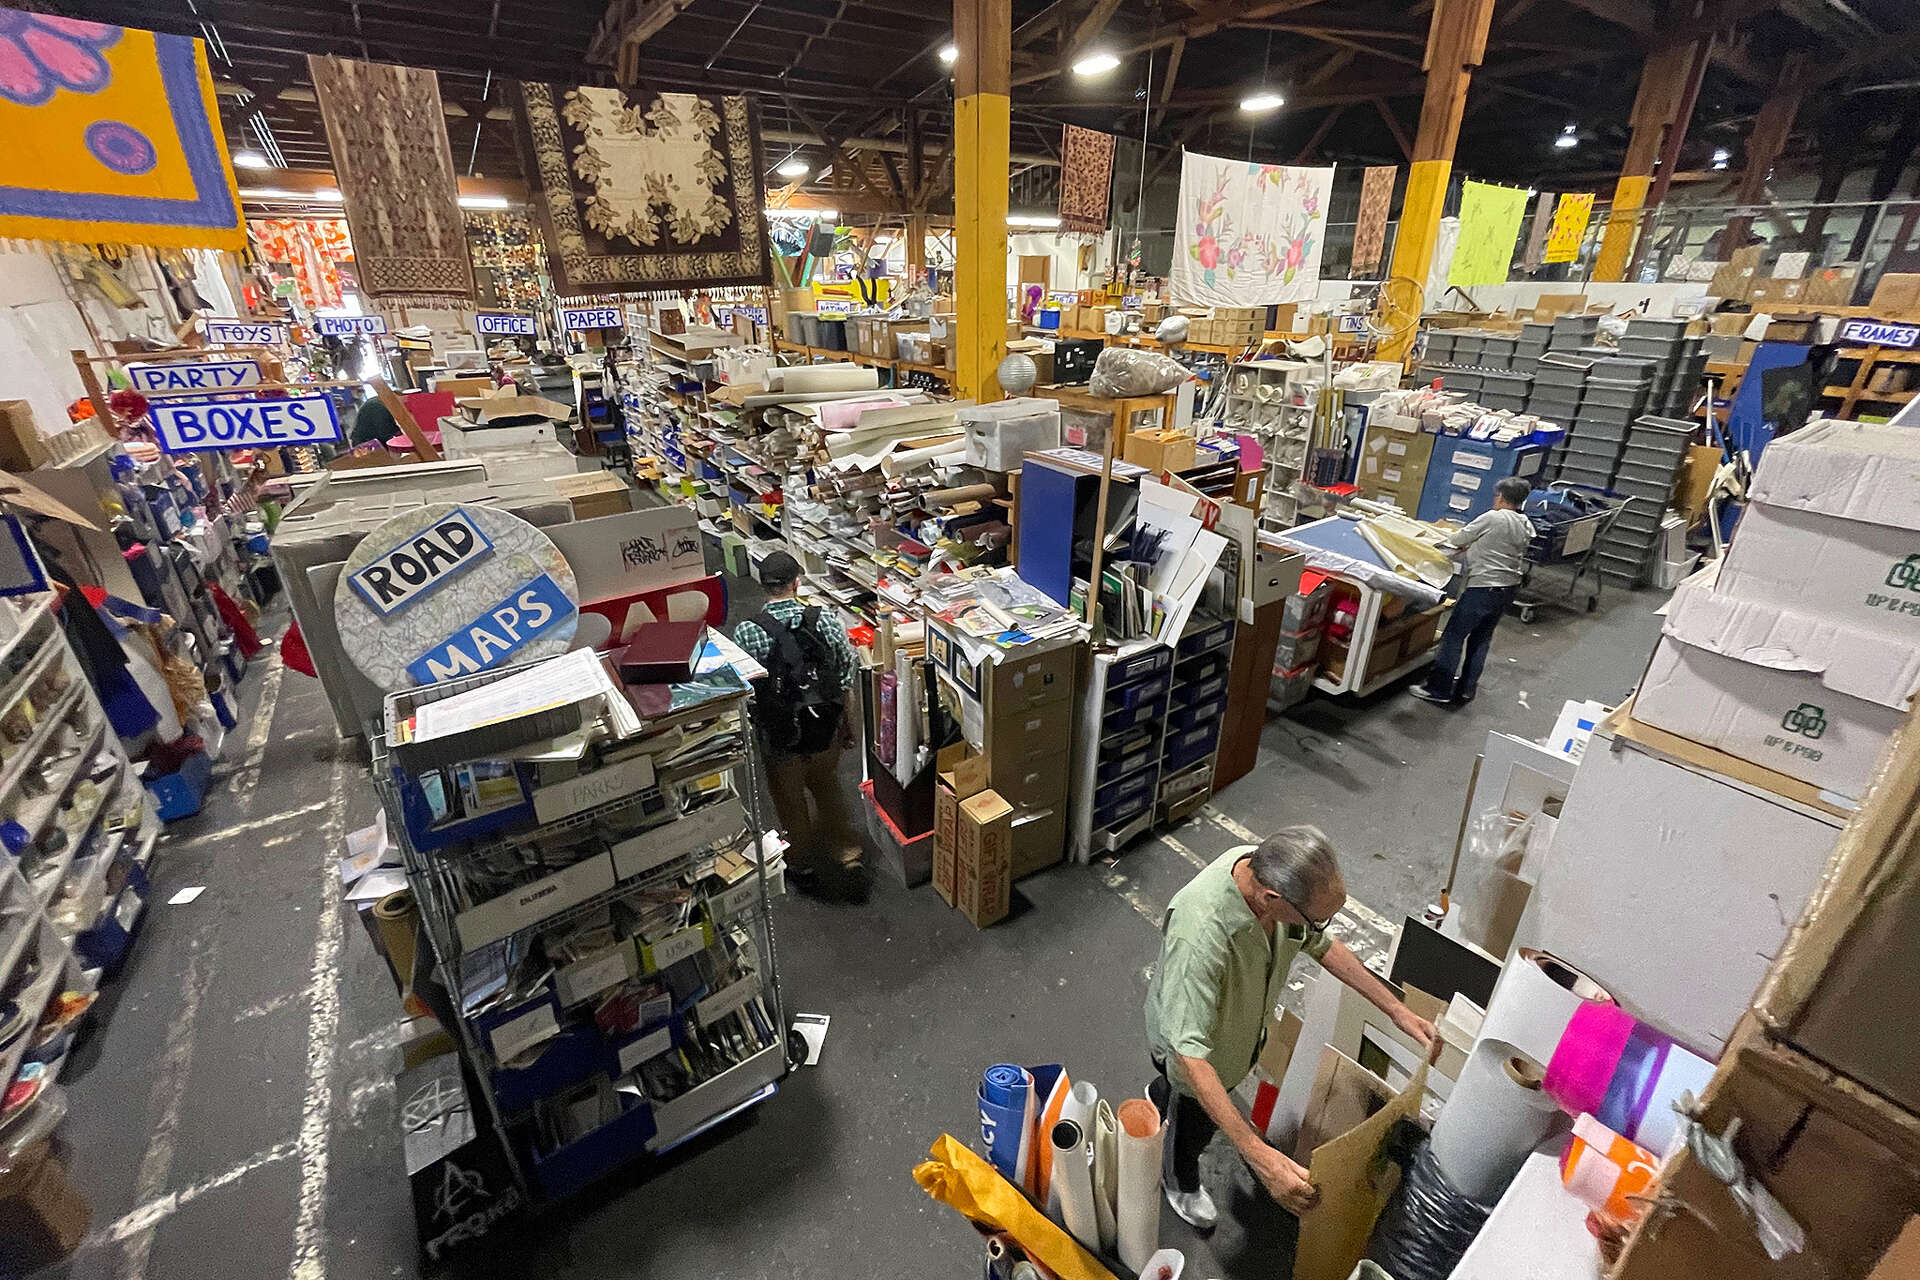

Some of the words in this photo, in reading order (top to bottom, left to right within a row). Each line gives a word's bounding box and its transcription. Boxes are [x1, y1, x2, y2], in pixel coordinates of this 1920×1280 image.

[325, 318, 375, 333] PHOTO
[482, 317, 527, 333] OFFICE
[568, 311, 617, 328] PAPER
[216, 326, 272, 342] TOYS
[1844, 323, 1915, 344] FRAMES
[144, 367, 248, 390] PARTY
[172, 402, 316, 443] BOXES
[361, 521, 474, 605] ROAD
[425, 590, 552, 682] MAPS
[572, 773, 624, 805] PARKS
